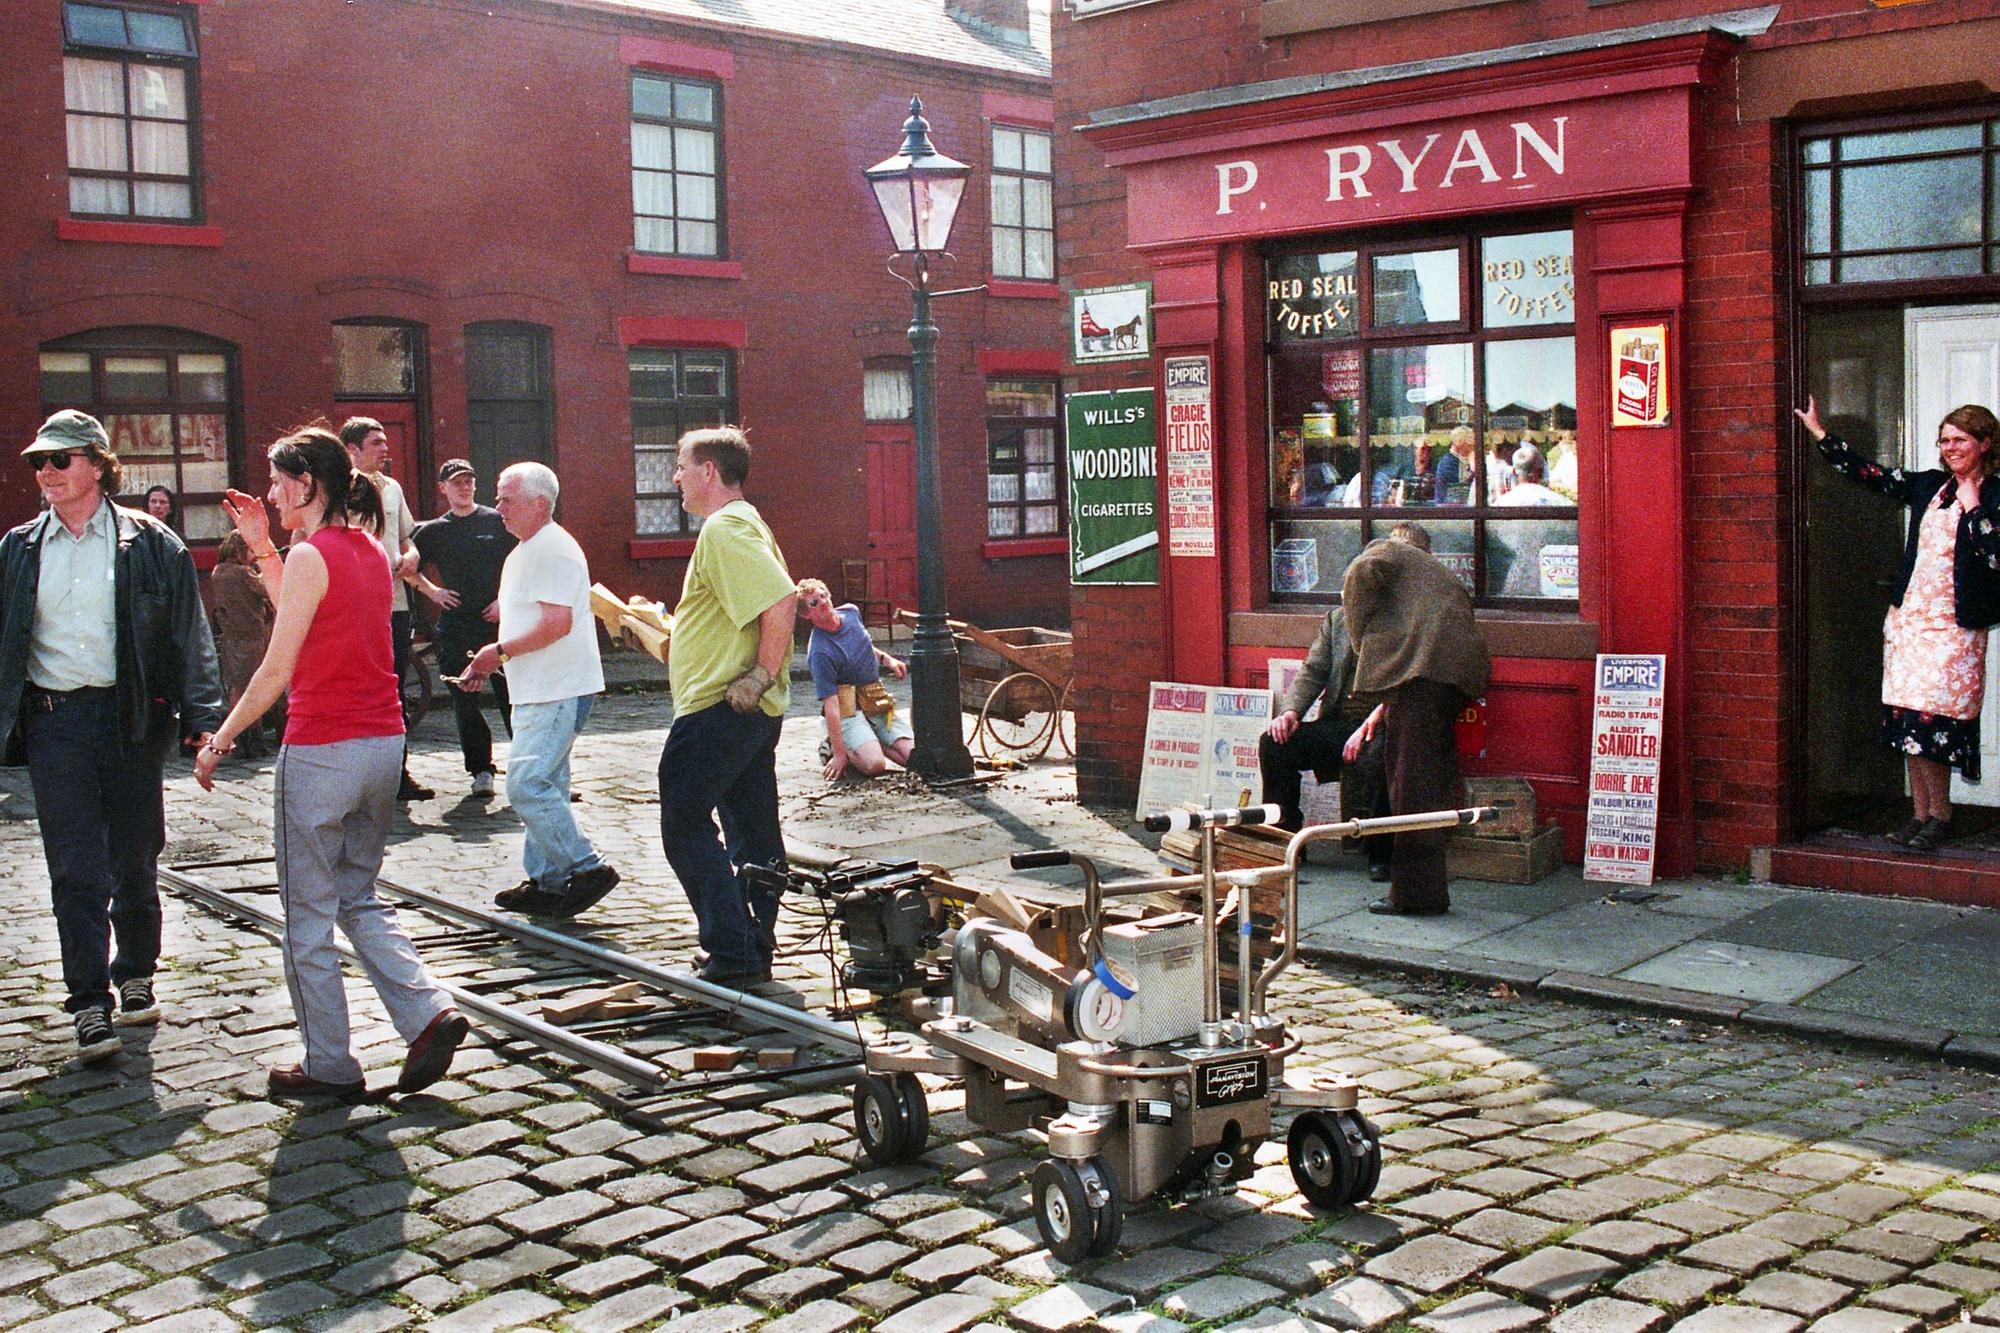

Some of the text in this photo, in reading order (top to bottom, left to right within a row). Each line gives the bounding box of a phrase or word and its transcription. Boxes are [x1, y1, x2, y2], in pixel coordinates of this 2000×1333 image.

[1215, 116, 1569, 215] P. RYAN
[1484, 255, 1574, 282] RED SEA
[1269, 274, 1359, 300] RED SEAL
[1494, 280, 1575, 319] TOFFEE
[1276, 299, 1351, 336] TOFFEE
[1168, 366, 1207, 387] EMPIRE
[1084, 406, 1146, 426] WILLS'S
[1170, 403, 1207, 422] GRACIE
[1168, 423, 1210, 453] FIELDS
[1081, 502, 1154, 517] CIGARETTES
[1603, 666, 1658, 688] EMPIRE
[1598, 710, 1659, 720] RADIO STARS
[1609, 725, 1646, 735] ALBERT
[1597, 733, 1657, 758] SANDLER
[1594, 773, 1655, 795] DORRIE DENE
[1622, 832, 1651, 843] KING
[1618, 846, 1651, 862] WATSON
